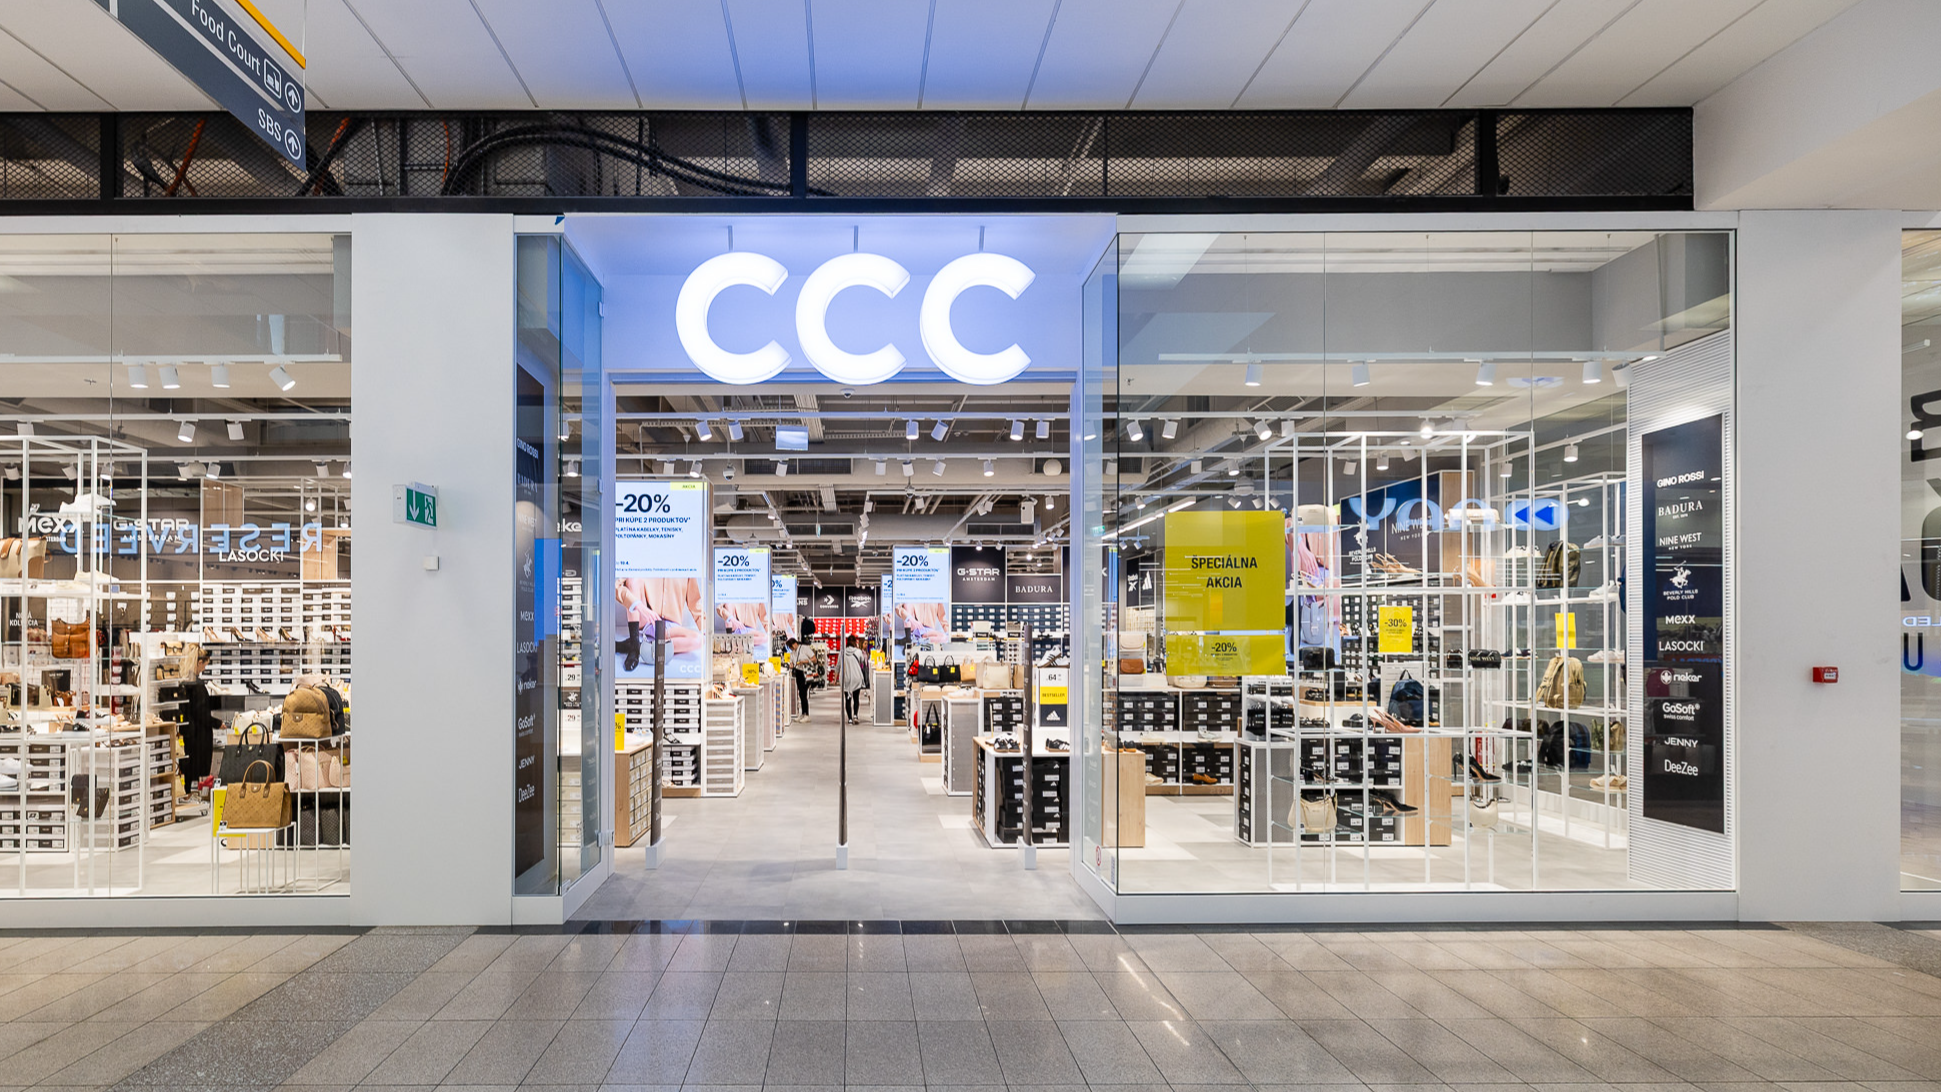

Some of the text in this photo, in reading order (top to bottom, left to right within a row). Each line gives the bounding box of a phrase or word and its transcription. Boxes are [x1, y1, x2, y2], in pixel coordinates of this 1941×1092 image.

[192, 0, 261, 77] Food Court
[258, 108, 281, 142] SBS
[675, 251, 1036, 385] CCC
[1657, 470, 1704, 488] GINO ROSSI
[615, 493, 671, 514] -20%
[1658, 500, 1703, 517] BADURA
[1659, 532, 1702, 546] NINE WEST
[717, 555, 750, 567] -20%
[896, 555, 929, 566] -20%
[1191, 554, 1258, 569] ŠPECIÁLNA
[1206, 576, 1243, 588] AKCIA
[1015, 585, 1054, 593] BADURA
[1384, 619, 1407, 627] -30%
[1211, 642, 1237, 652] -20%
[1658, 641, 1704, 651] LASOCKI
[680, 665, 701, 674] CCC
[1664, 737, 1698, 748] JENNY
[1664, 759, 1699, 776] DeeZee
